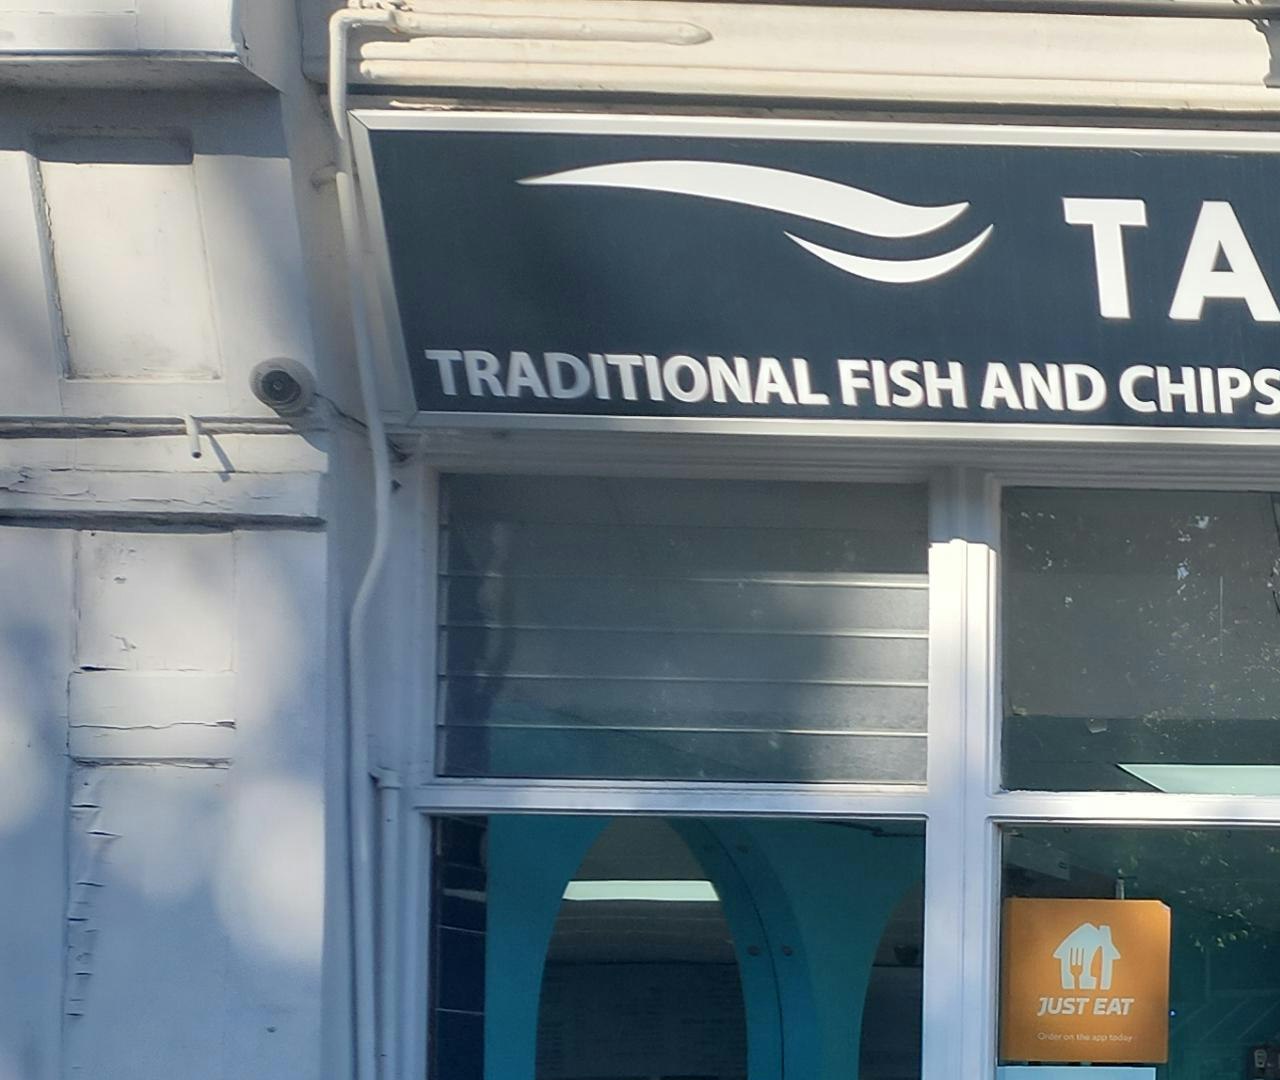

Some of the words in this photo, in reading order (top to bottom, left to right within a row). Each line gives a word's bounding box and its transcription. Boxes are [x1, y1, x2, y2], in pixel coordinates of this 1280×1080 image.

[425, 350, 830, 406] TRADITIONAL
[838, 360, 966, 407] FISH
[981, 363, 1106, 411] AND
[1037, 997, 1089, 1016] JUST
[1093, 997, 1134, 1016] EAT
[1037, 1031, 1060, 1040] Order
[1076, 1031, 1090, 1040] the
[1092, 1033, 1108, 1043] app
[1110, 1031, 1133, 1043] today
